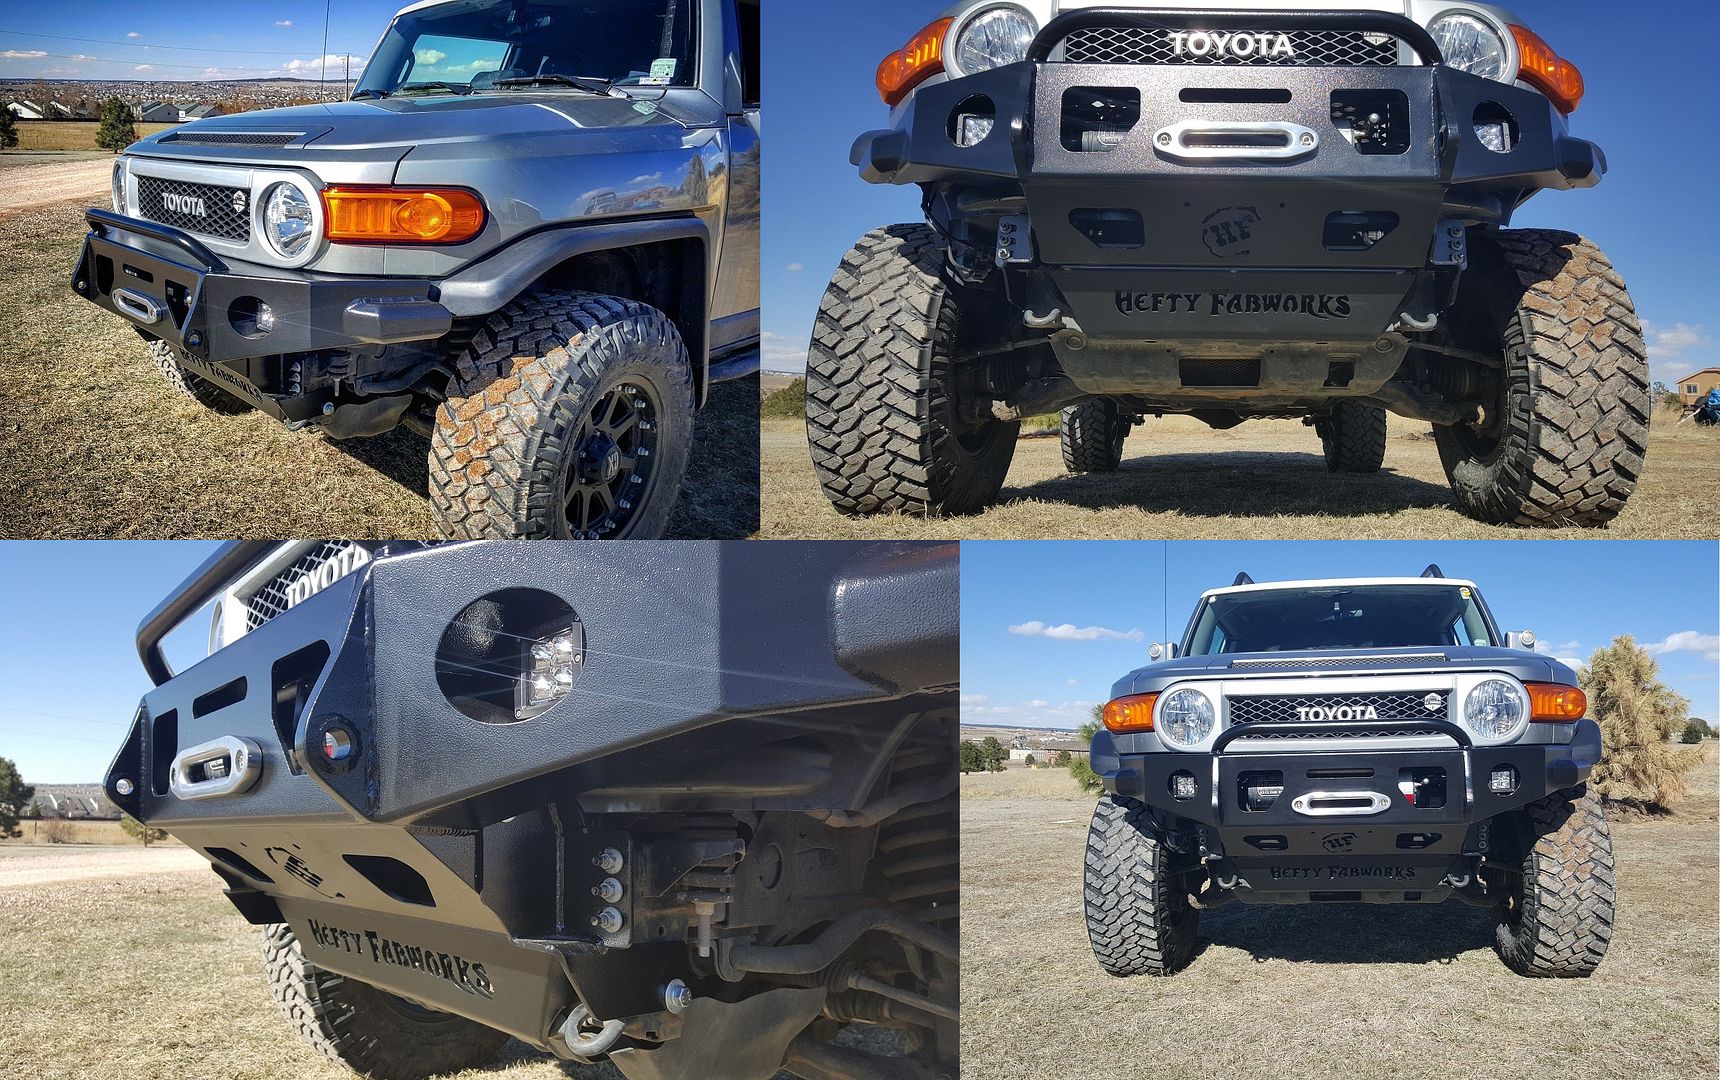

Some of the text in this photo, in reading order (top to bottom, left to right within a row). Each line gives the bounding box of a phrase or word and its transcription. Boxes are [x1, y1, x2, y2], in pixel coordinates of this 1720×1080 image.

[1169, 32, 1295, 58] TOYOTA
[162, 192, 206, 217] TOYOTA
[1209, 214, 1254, 248] HF
[1114, 289, 1351, 320] HEFTY FABWORKS
[285, 543, 371, 609] TOYOTA
[1296, 706, 1378, 721] TOYOTA
[1270, 864, 1416, 881] HEFTY FABWORKS
[307, 918, 495, 1000] HEFTY FABWORKS
